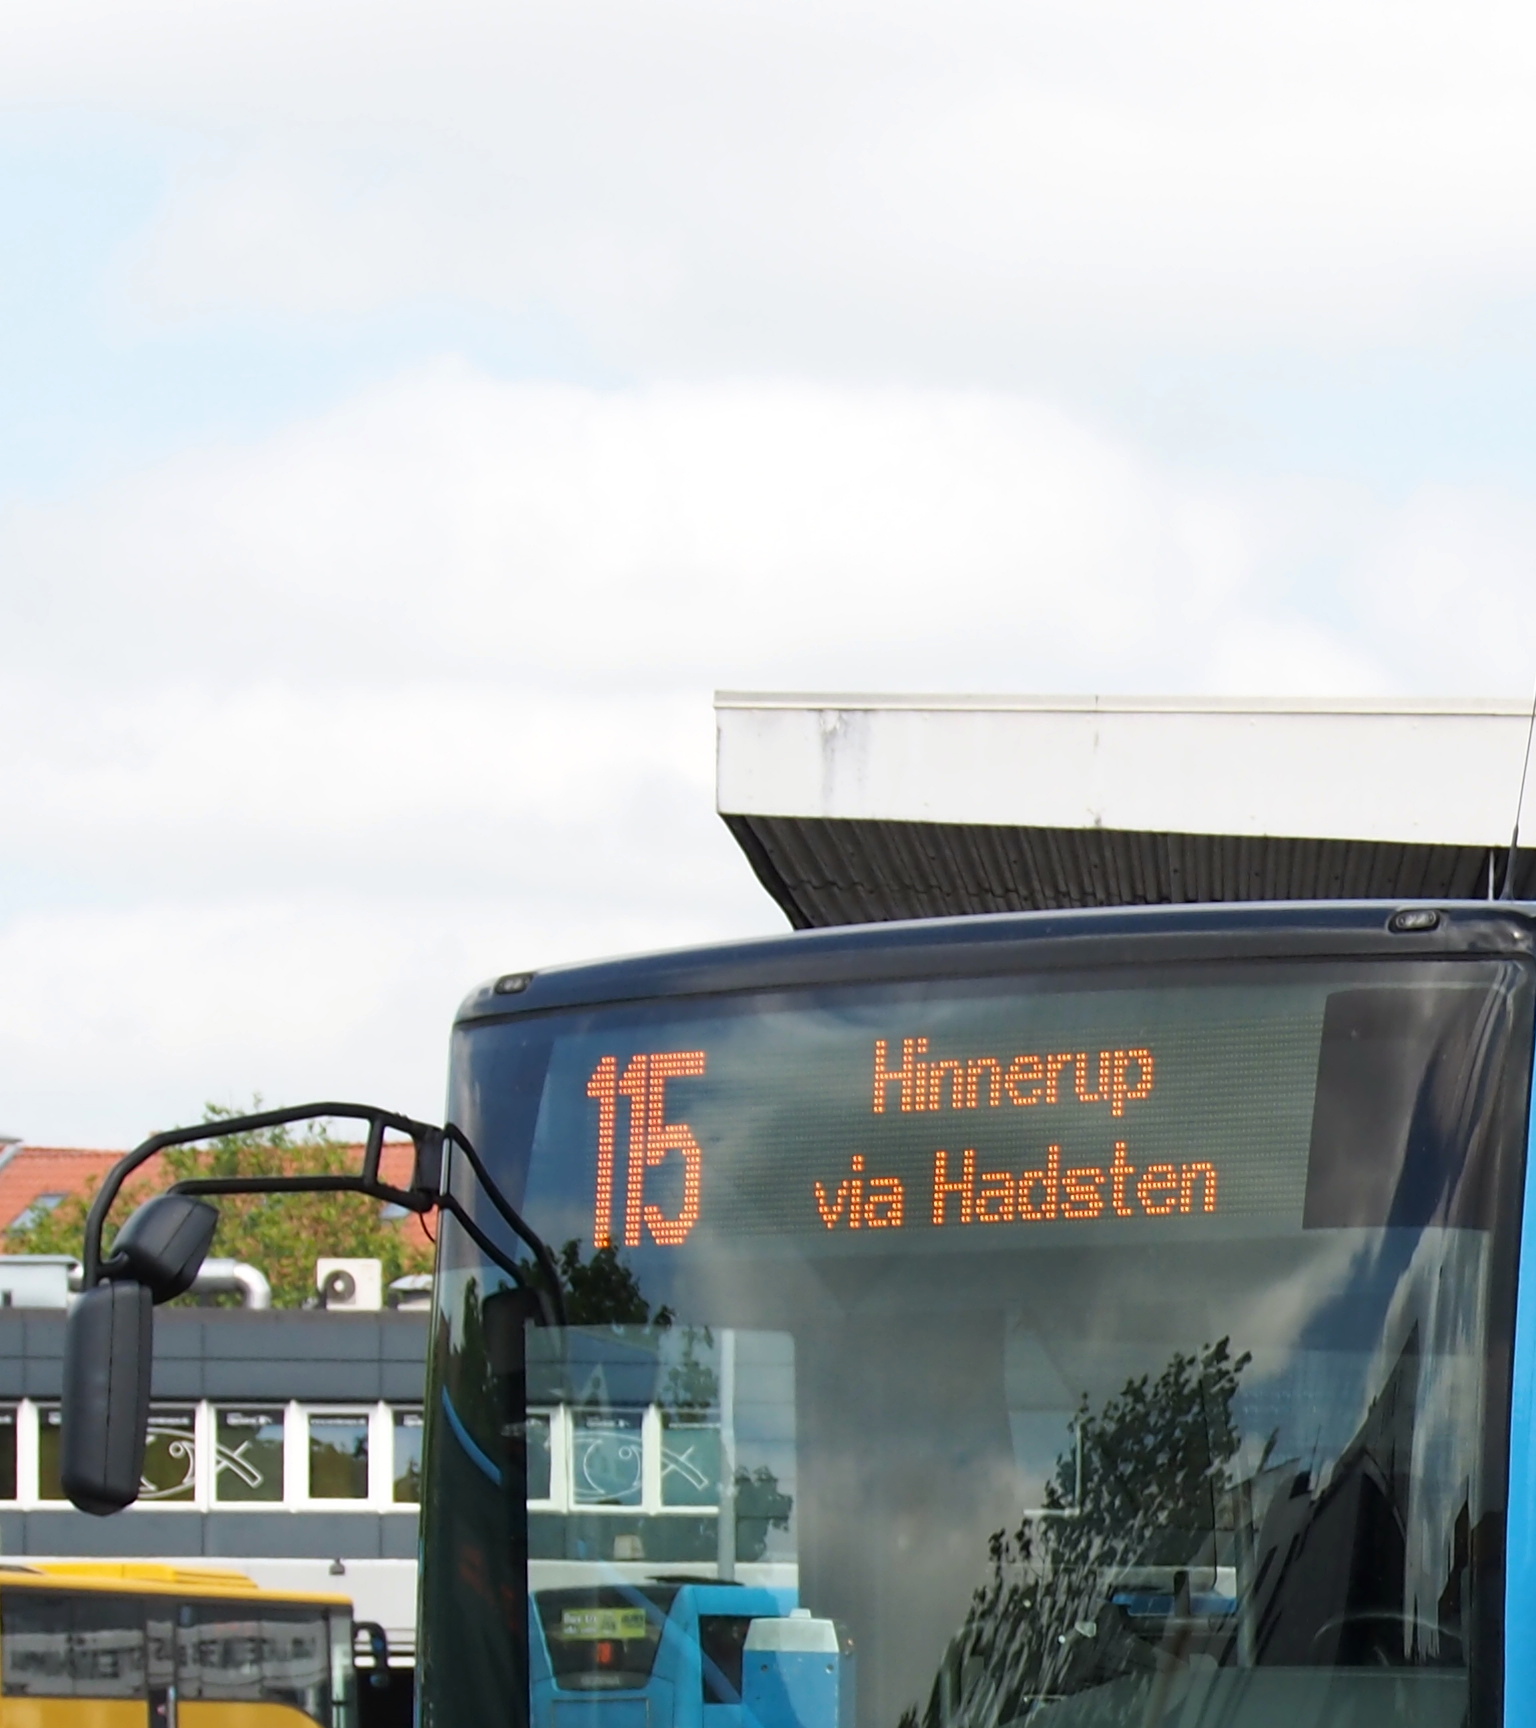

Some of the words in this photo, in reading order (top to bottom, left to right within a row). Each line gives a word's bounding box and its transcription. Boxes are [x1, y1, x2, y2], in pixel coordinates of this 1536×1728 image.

[871, 1037, 1154, 1117] Hinnerup
[587, 1051, 706, 1248] 115
[815, 1154, 905, 1229] via
[932, 1141, 1218, 1225] Hadsten
